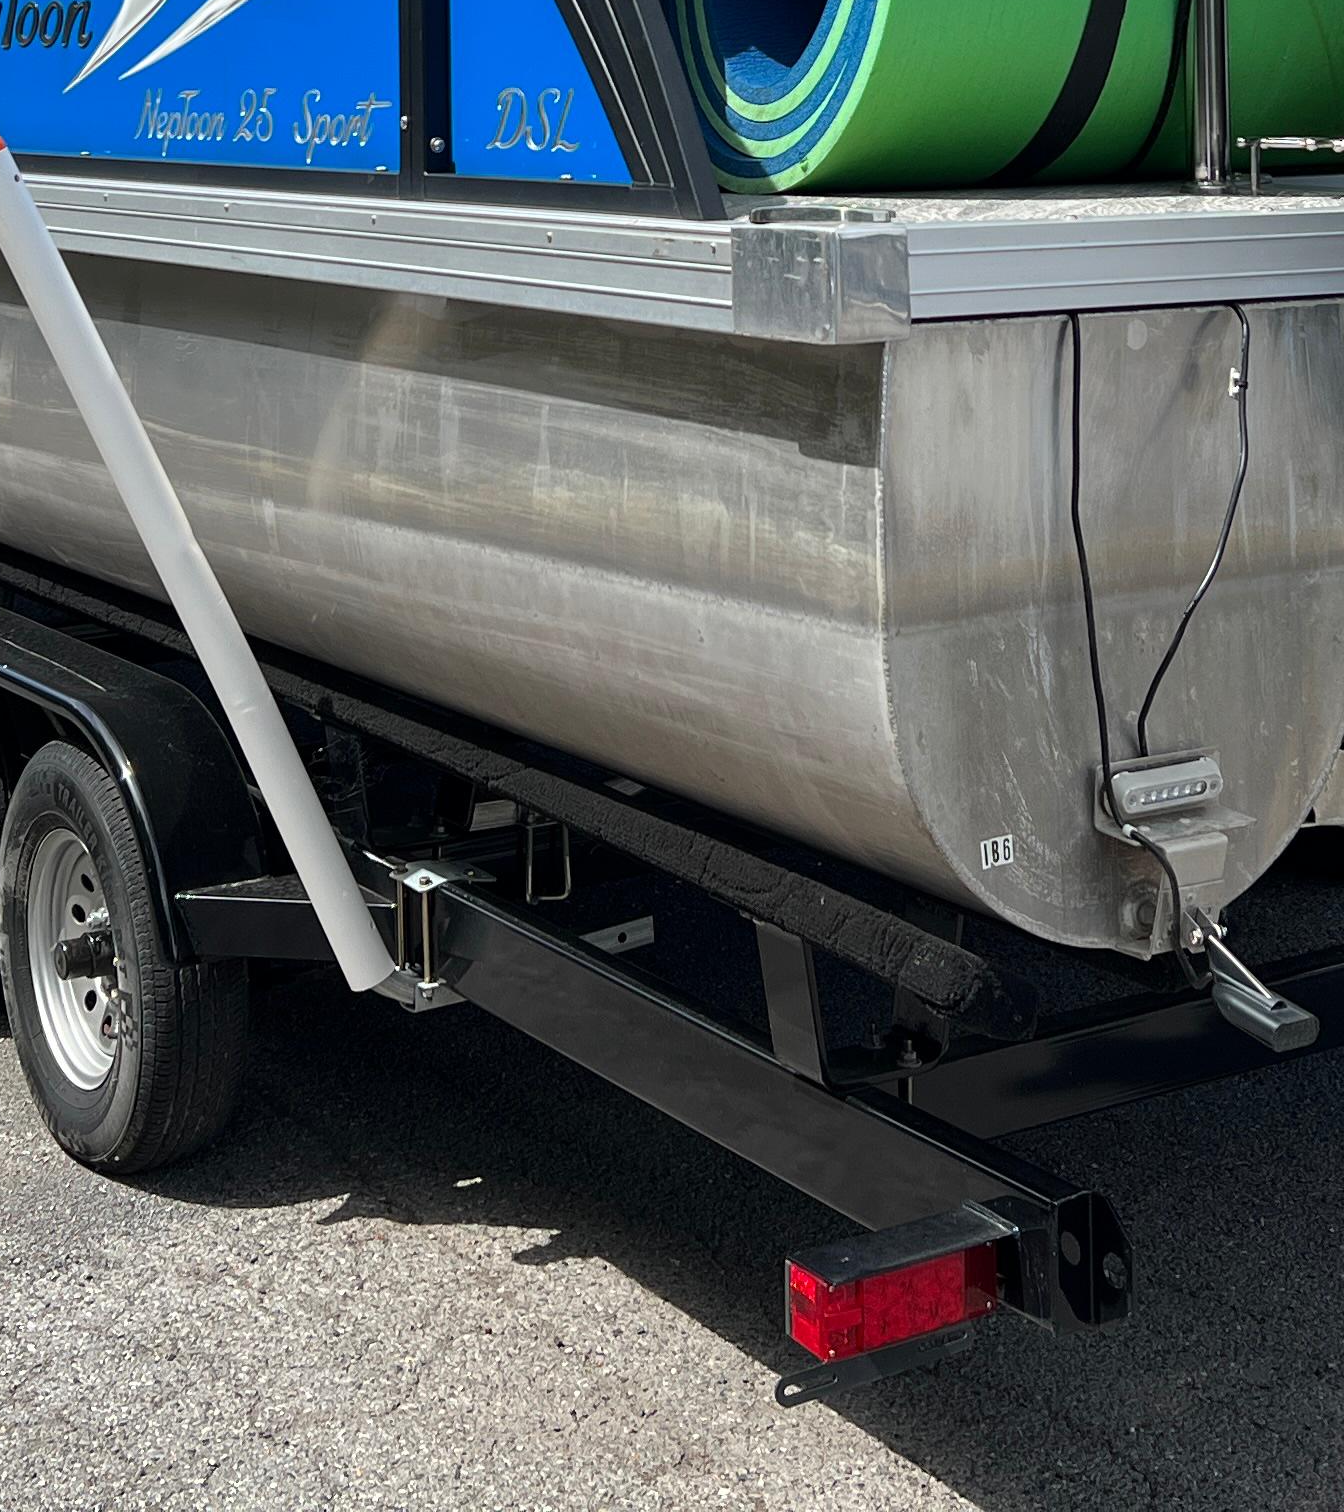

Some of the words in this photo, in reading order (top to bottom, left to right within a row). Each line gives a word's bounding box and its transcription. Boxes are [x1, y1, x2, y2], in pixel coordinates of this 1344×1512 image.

[233, 88, 277, 142] 25
[293, 89, 392, 164] Sport
[485, 87, 581, 152] DSL
